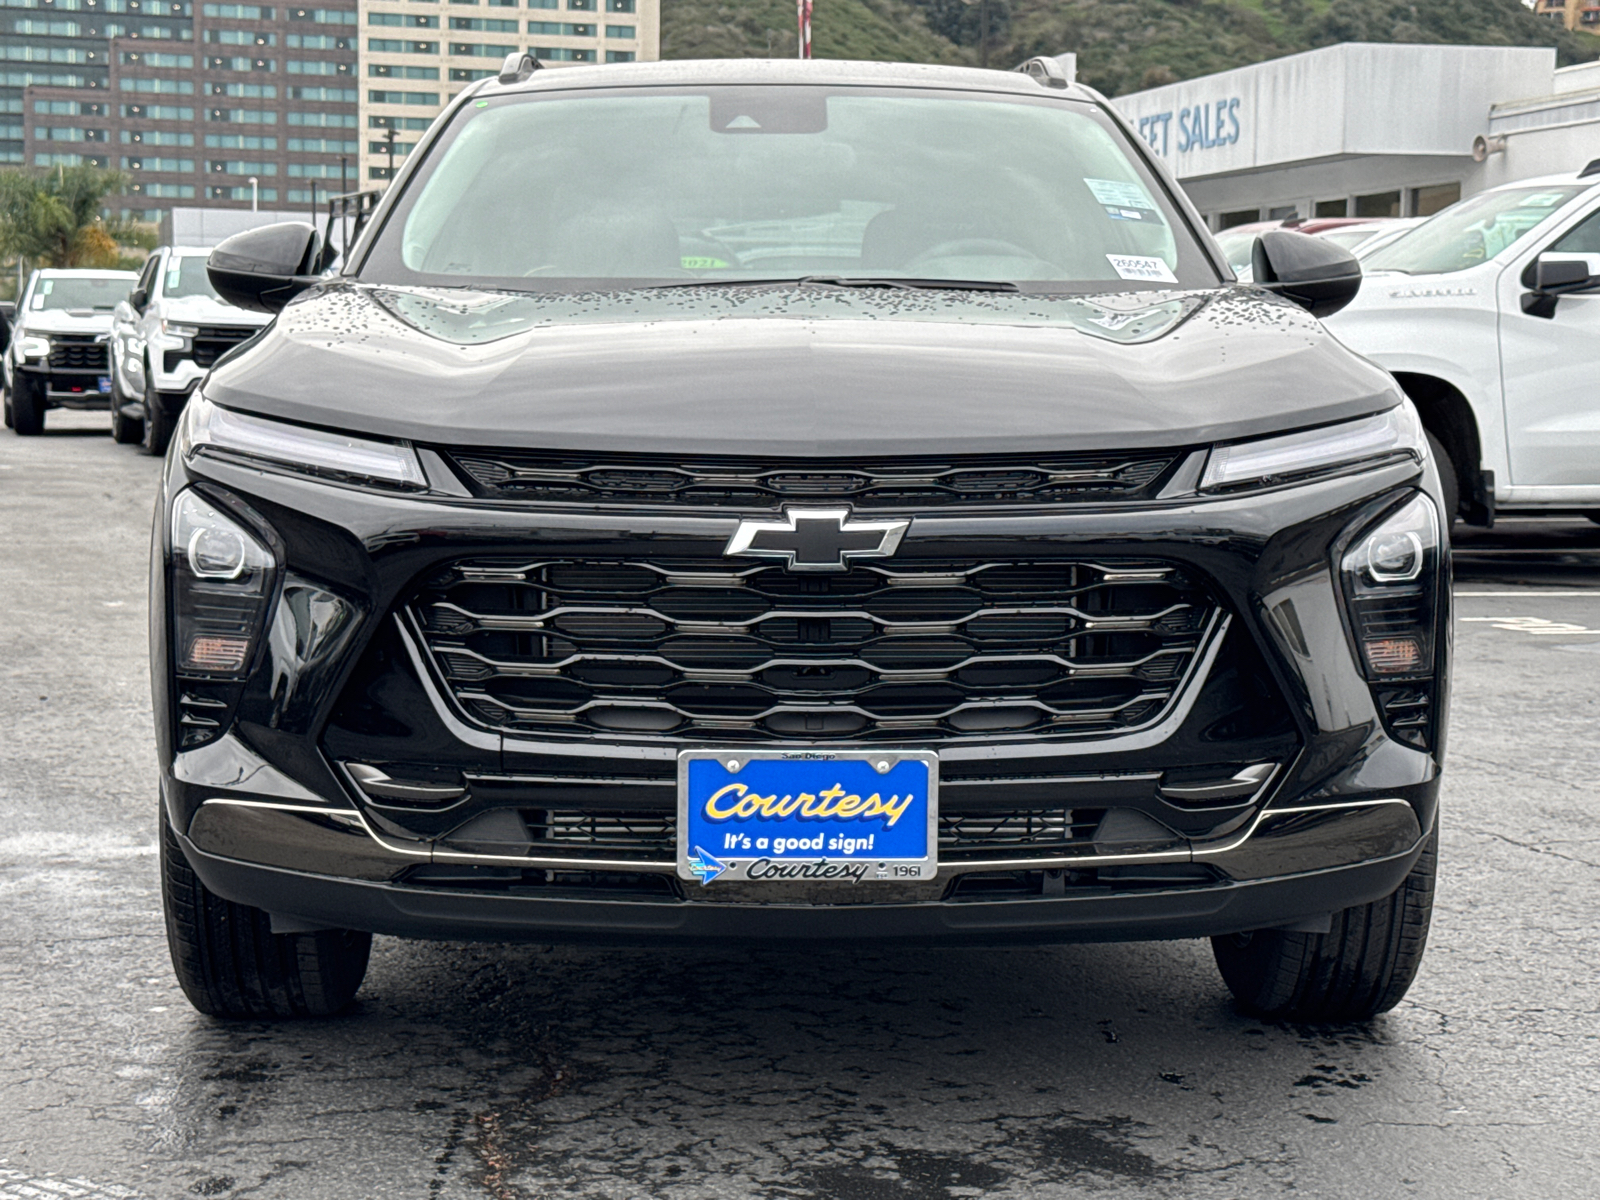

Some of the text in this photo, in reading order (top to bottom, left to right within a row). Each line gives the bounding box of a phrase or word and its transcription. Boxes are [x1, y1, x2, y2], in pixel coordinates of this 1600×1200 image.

[1178, 97, 1240, 153] SALES
[1112, 258, 1158, 269] 260547
[781, 752, 836, 761] San Diego
[705, 783, 914, 827] Courtesy
[724, 833, 874, 854] It's a good sign!
[746, 856, 869, 884] Courtesy
[893, 865, 921, 877] 1961
